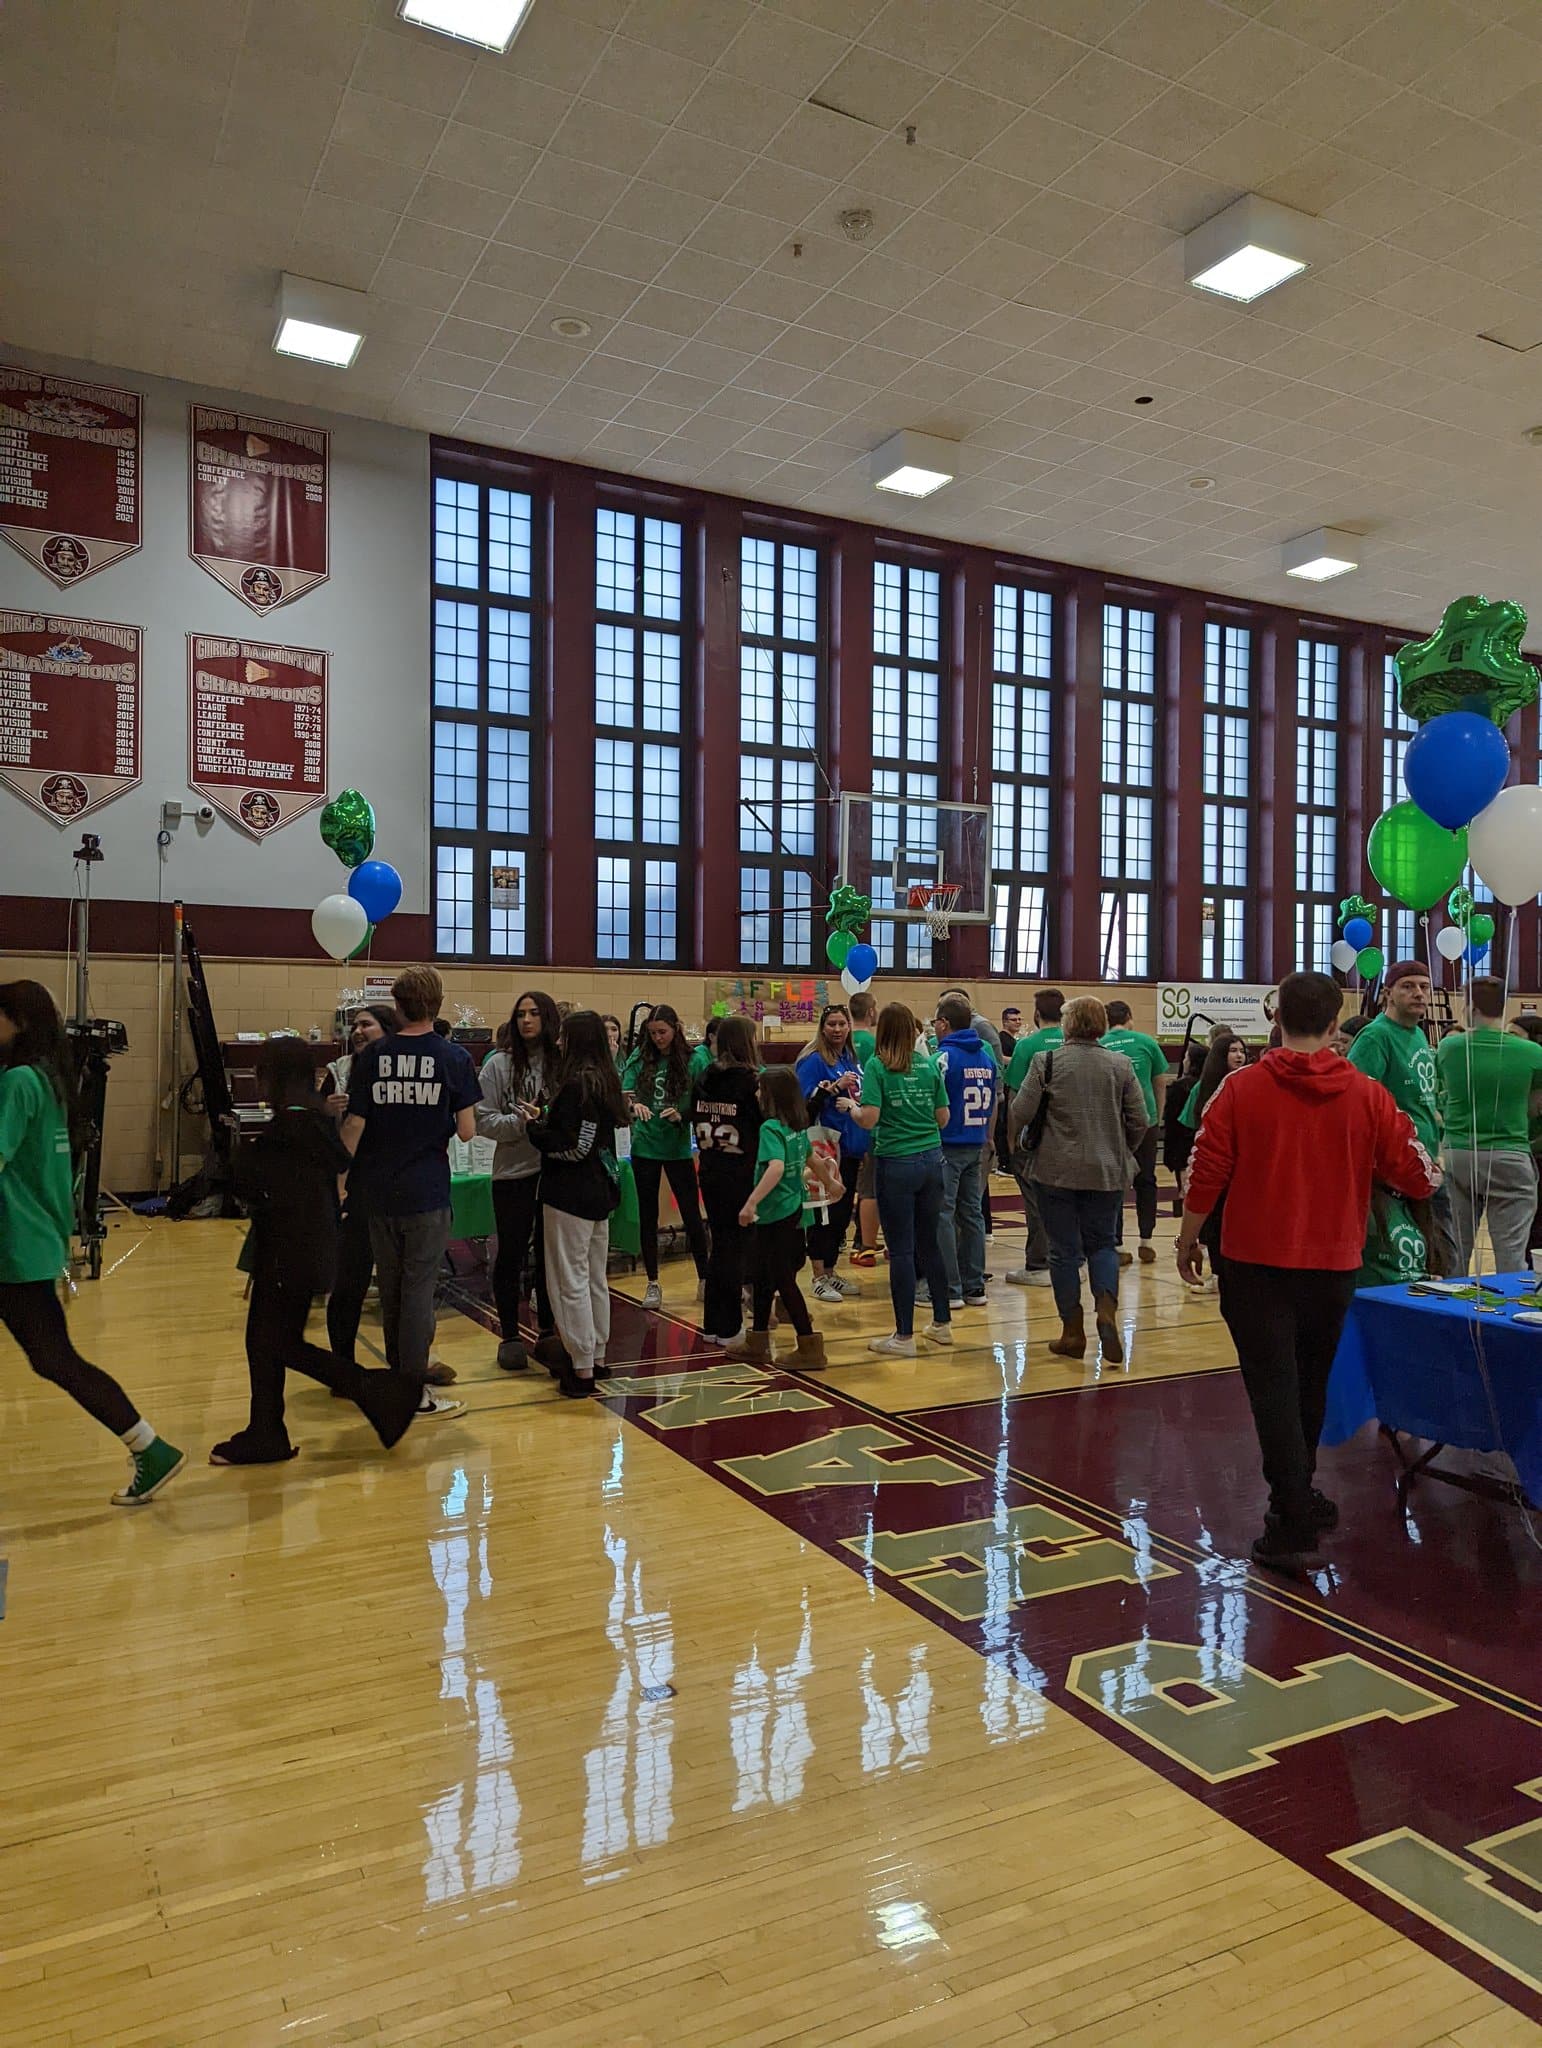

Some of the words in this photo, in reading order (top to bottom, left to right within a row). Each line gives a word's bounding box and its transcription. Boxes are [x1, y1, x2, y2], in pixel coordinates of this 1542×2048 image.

[0, 426, 28, 439] OUNTY
[197, 409, 236, 431] BOYS
[238, 417, 323, 455] BADMINTON
[0, 436, 29, 449] OUNTY
[0, 446, 48, 462] ONFERENCE
[0, 455, 48, 471] ONFERENCE
[197, 441, 324, 483] CHAMPIONS
[0, 466, 32, 478] IVISION
[198, 464, 245, 479] CONFERENCE
[0, 475, 32, 487] IVISION
[198, 472, 228, 485] COUNTY
[0, 484, 48, 499] ONFERENCE
[0, 493, 47, 509] ONFERENCE
[48, 619, 136, 652] SWIMMING
[196, 639, 239, 660] GIRLS
[241, 645, 322, 677] BADMINTON
[196, 670, 322, 705] CHAMPIONS
[0, 698, 48, 711] ONFERENCE
[197, 693, 244, 705] CONFERENCE
[197, 702, 226, 712] LEAGUE
[197, 711, 226, 720] LEAGUE
[197, 719, 244, 731] CONFERENCE
[0, 727, 48, 739] ONFERENCE
[197, 728, 244, 740] CONFERENCE
[197, 737, 227, 747] COUNTY
[197, 745, 245, 757] CONFERENCE
[197, 755, 246, 767] UNDEFEATED
[248, 760, 294, 772] CONFERENCE
[198, 764, 245, 775] UNDEFEATED
[248, 768, 292, 779] CONFERENCE
[715, 980, 827, 1006] RAFFLES
[1194, 996, 1208, 1004] Help
[372, 1081, 442, 1105] CREW
